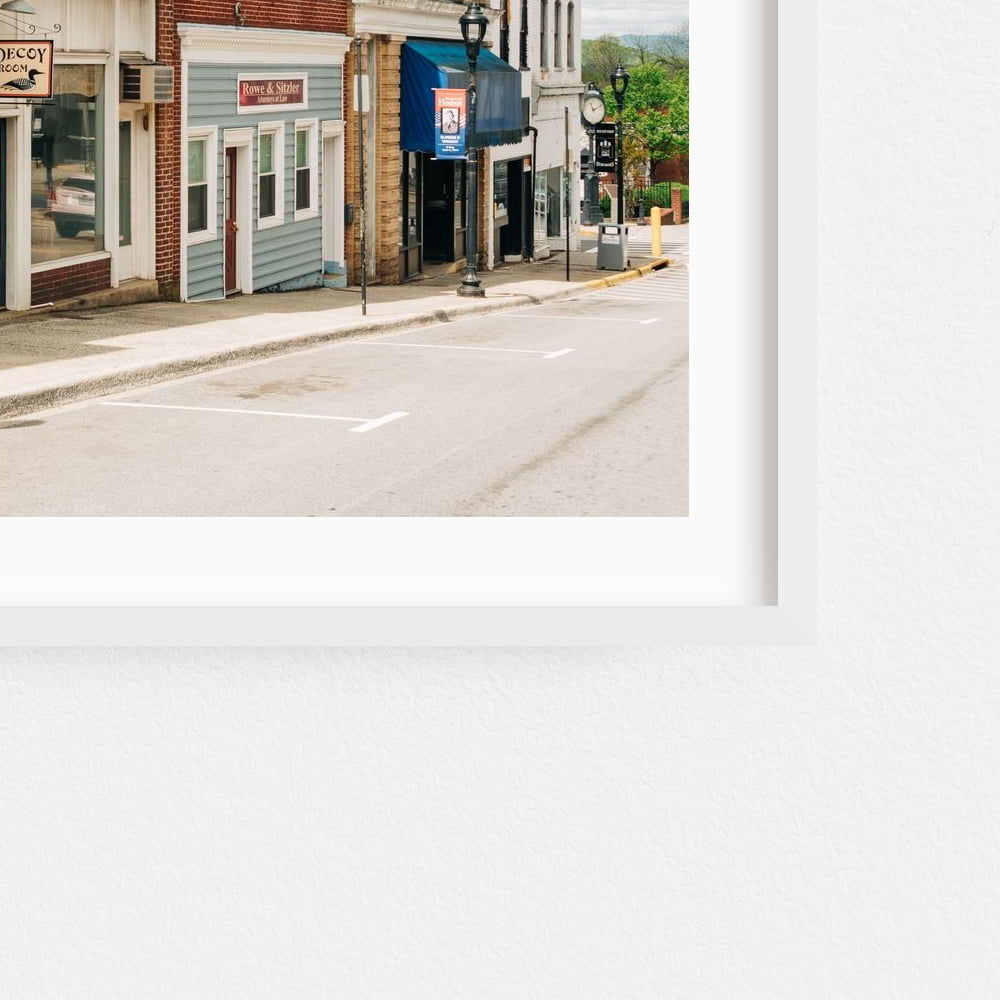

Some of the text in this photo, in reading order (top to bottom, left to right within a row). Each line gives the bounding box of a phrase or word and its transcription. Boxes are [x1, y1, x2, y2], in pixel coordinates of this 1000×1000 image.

[242, 81, 300, 95] Rowe & Sitzler
